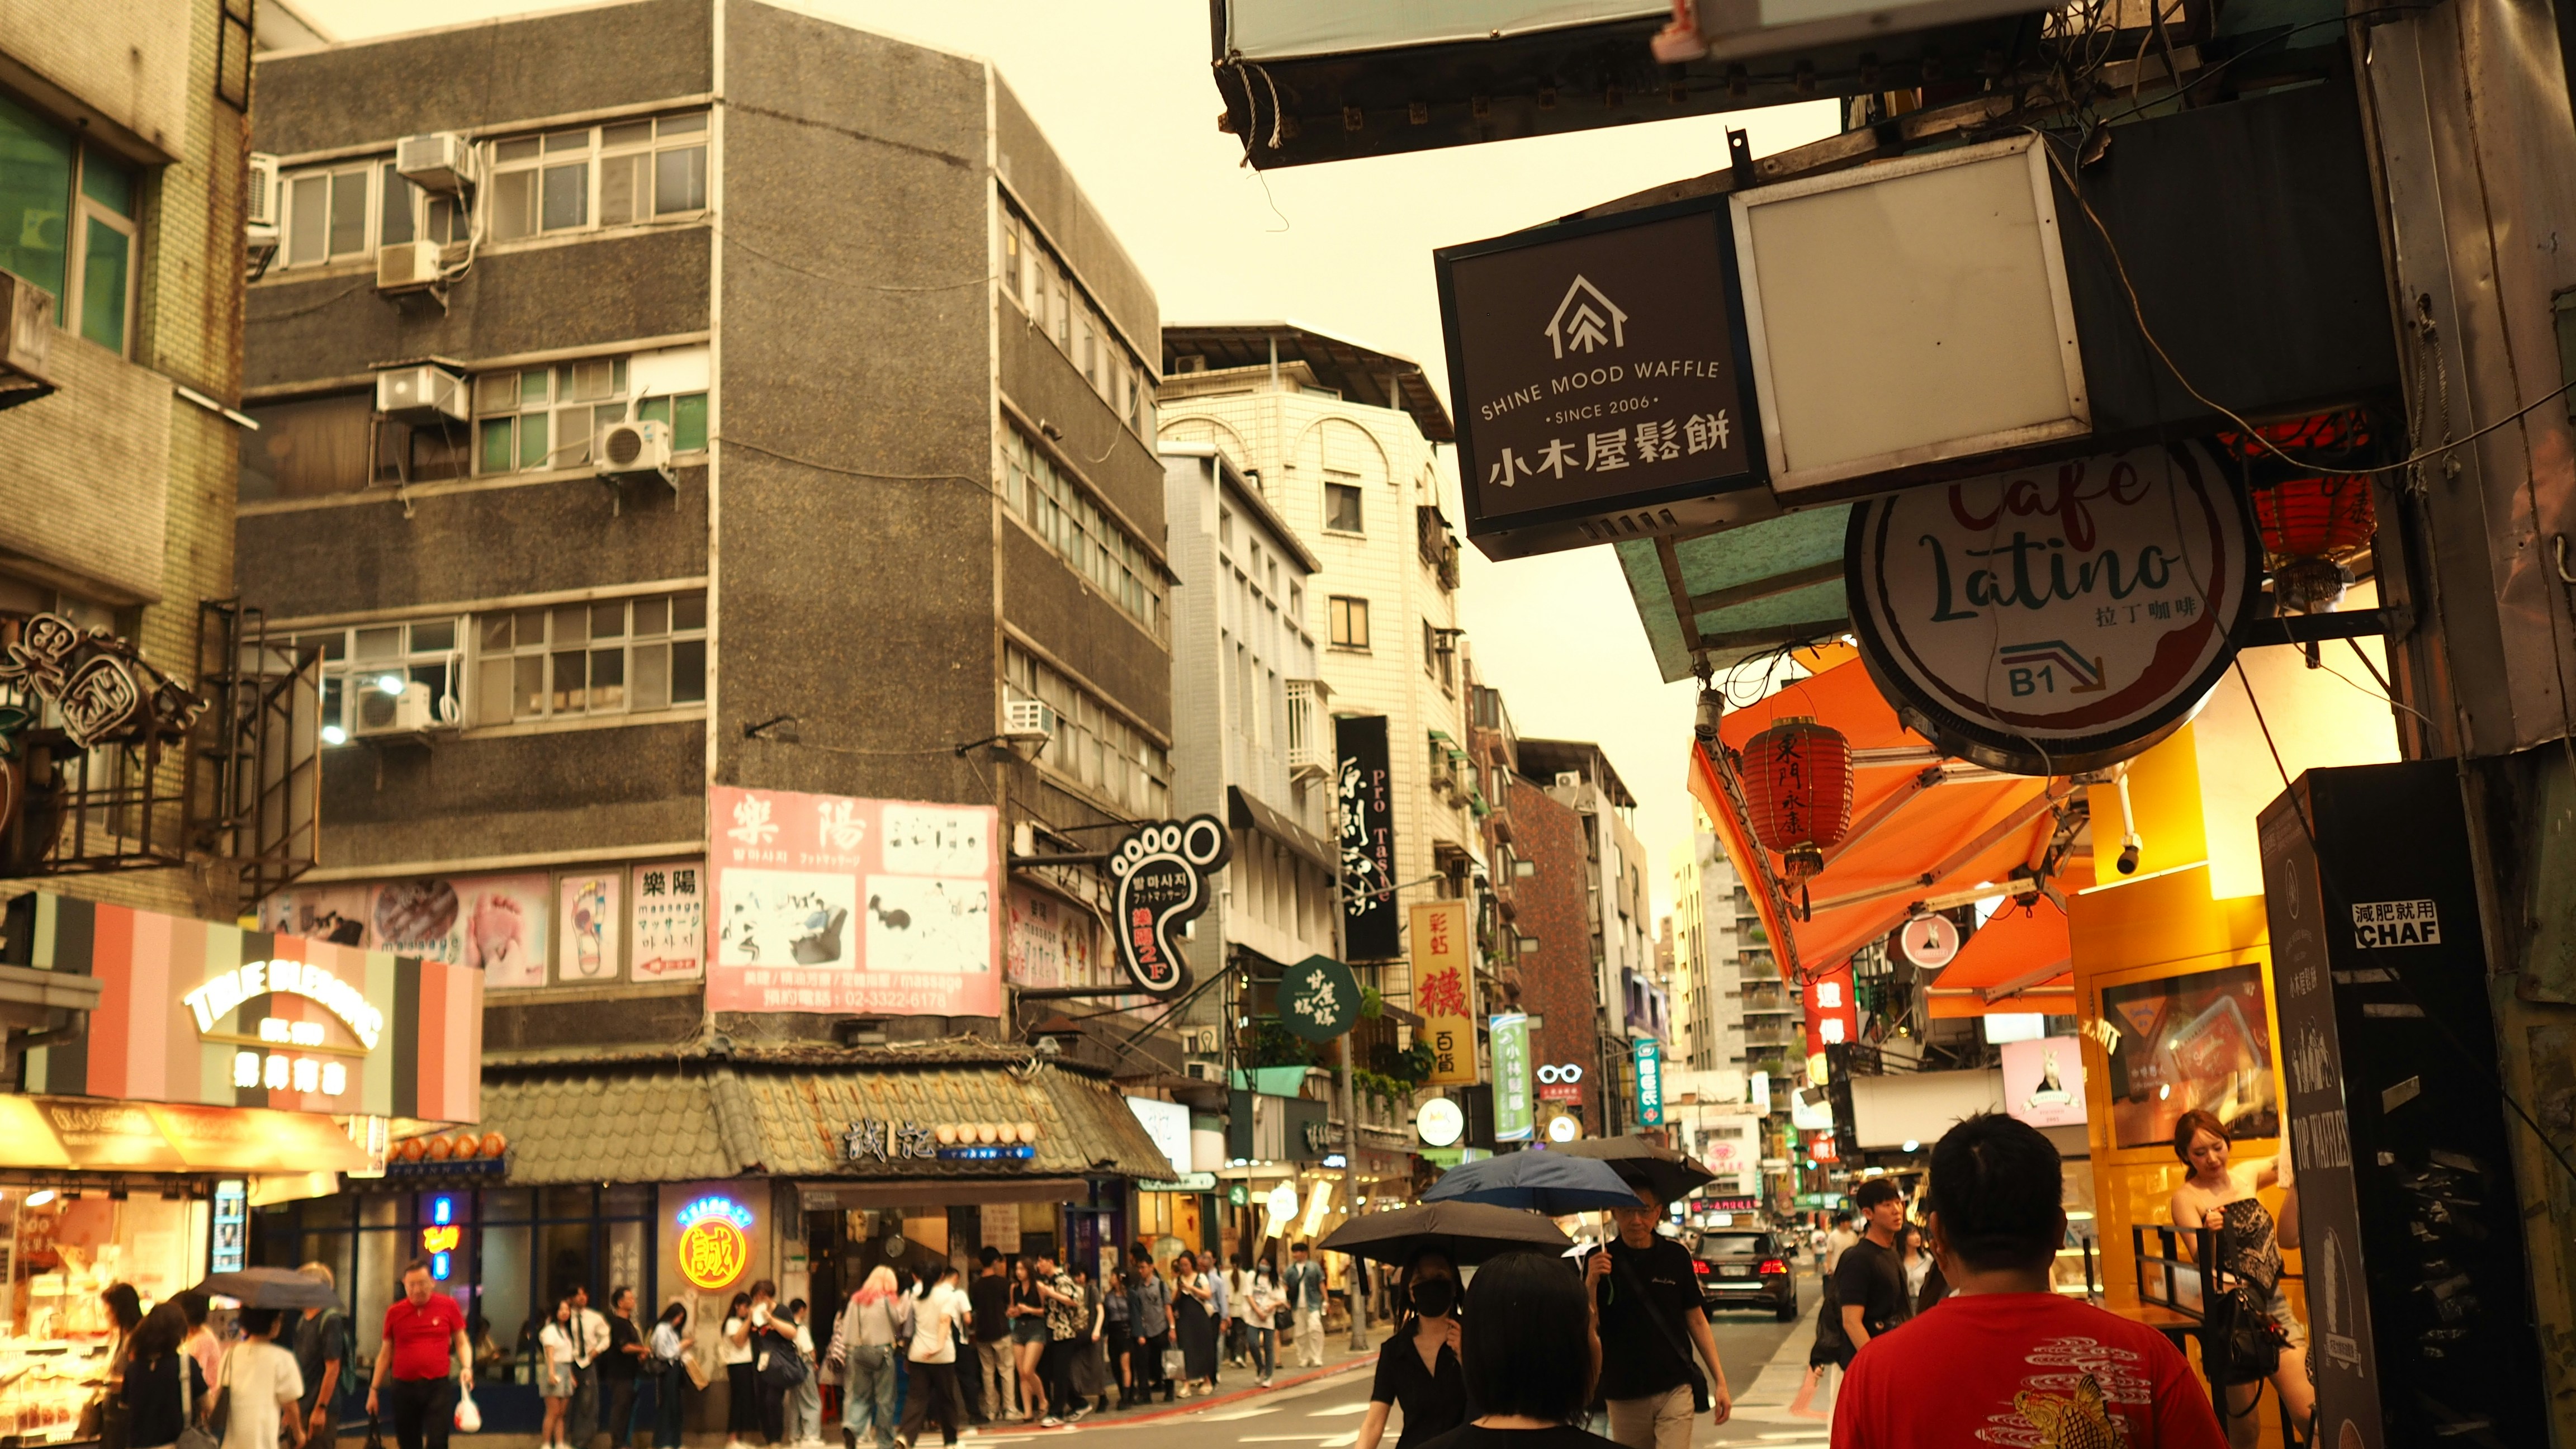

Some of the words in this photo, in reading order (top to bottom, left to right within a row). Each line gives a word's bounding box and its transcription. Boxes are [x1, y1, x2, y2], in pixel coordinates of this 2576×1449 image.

[1481, 385, 1542, 420] SHINE
[1551, 366, 1623, 394] MOOD
[1635, 361, 1718, 378] WAFFLE
[1556, 405, 1602, 424] SINCE
[1610, 396, 1649, 414] 2006
[1489, 409, 1730, 487] 小木屋鬆餅
[1919, 532, 2180, 622] Latino
[2096, 596, 2197, 627] 拉丁咖啡
[2009, 665, 2054, 697] B1
[1372, 769, 1386, 812] Pro
[1775, 733, 1807, 835] 東門永康
[642, 869, 695, 897] 樂陽
[1133, 872, 1187, 891] 발마사지
[1374, 828, 1390, 902] Taste
[1429, 912, 1448, 955] 彩虹
[2355, 901, 2435, 923] 減肥就用
[2357, 921, 2436, 947] CHAF
[1436, 1031, 1455, 1074] 百貨
[2293, 1116, 2310, 1171] TOP
[2309, 1109, 2351, 1169] WAFFLES
[691, 1227, 733, 1277] 誠
